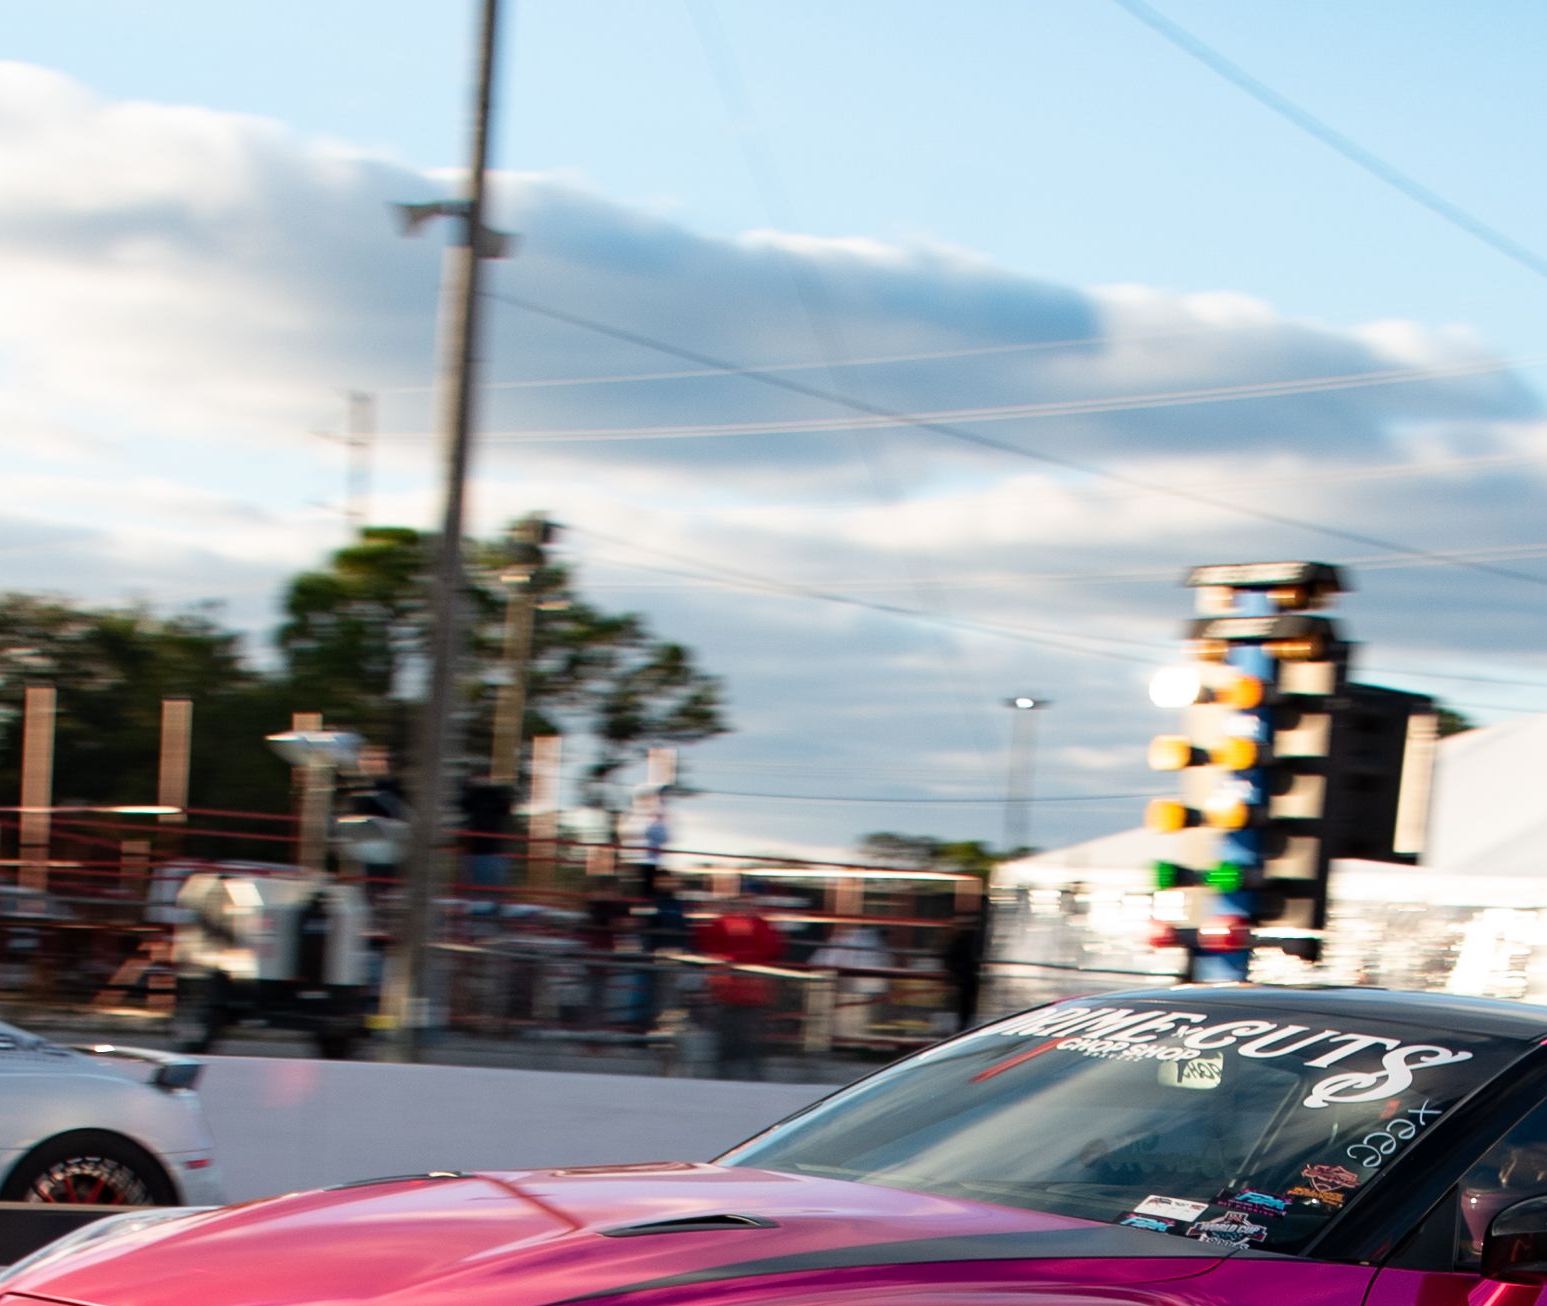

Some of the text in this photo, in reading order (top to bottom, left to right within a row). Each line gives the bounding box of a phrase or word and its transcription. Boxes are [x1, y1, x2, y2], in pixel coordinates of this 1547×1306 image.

[1056, 1037, 1131, 1053] CHOP
[1123, 1044, 1202, 1062] SHOP
[1184, 1019, 1473, 1108] CUTS
